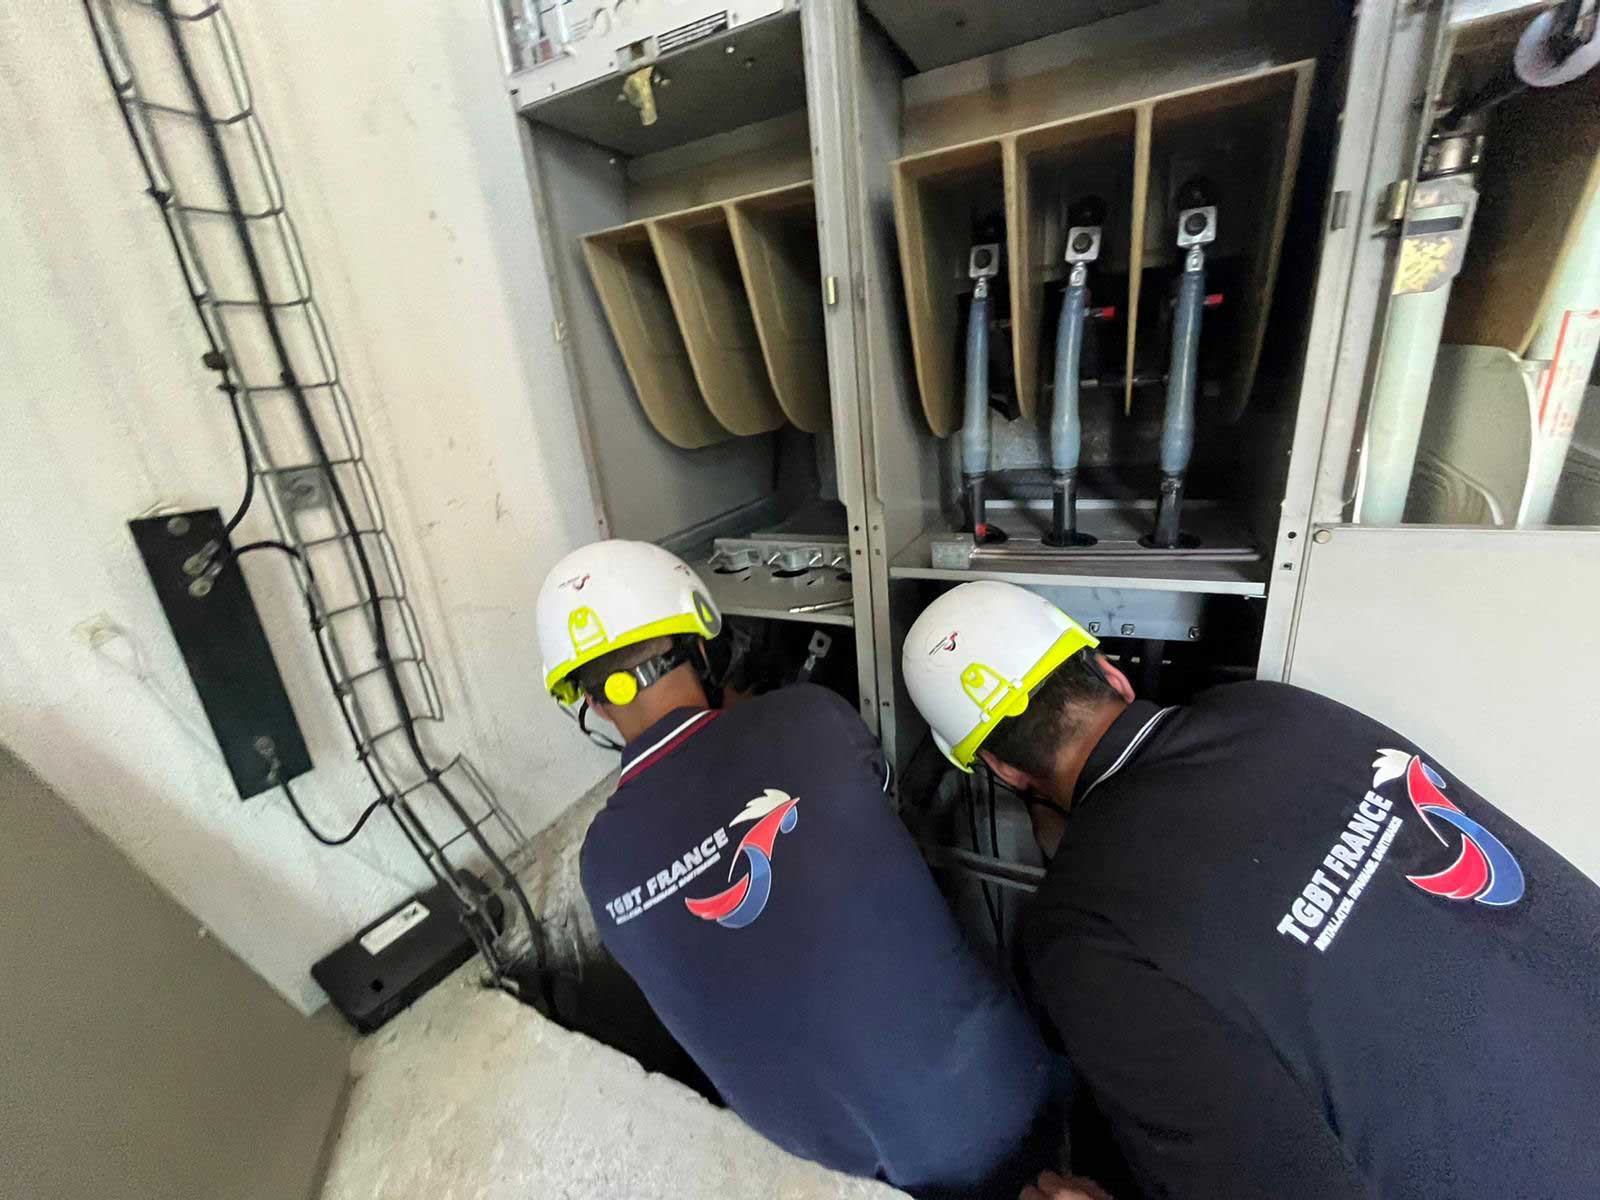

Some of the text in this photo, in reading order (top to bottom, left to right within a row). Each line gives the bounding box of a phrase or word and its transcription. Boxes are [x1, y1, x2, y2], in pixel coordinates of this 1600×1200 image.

[606, 885, 642, 919] TGBT
[647, 827, 729, 897] FRANCE
[1276, 868, 1342, 944] TGBT
[1323, 790, 1394, 881] FRANCE
